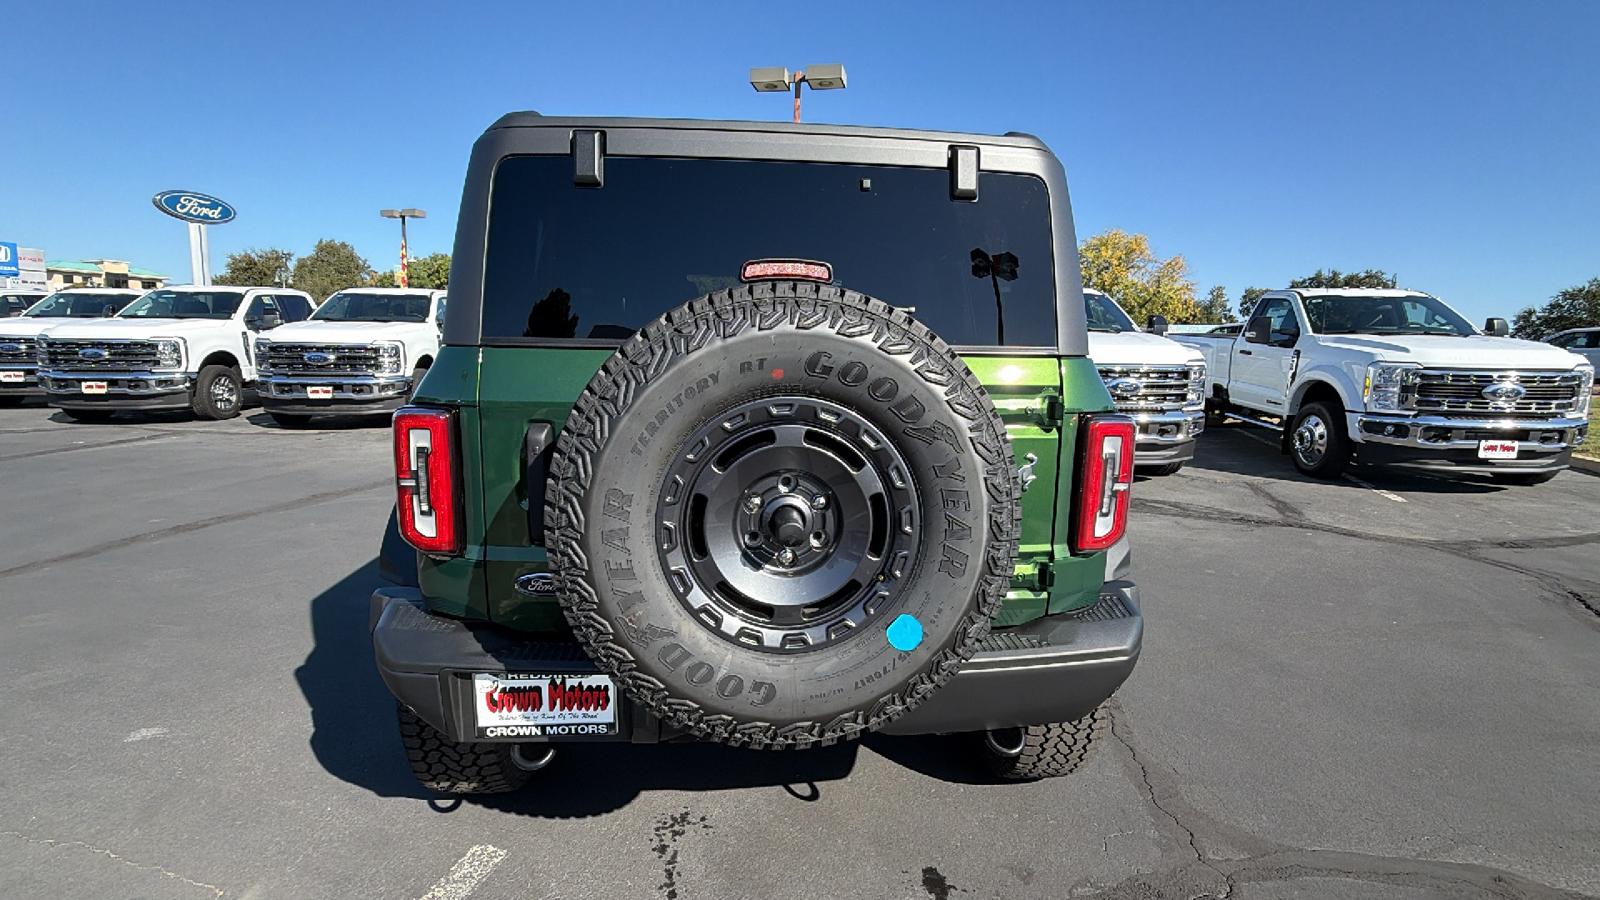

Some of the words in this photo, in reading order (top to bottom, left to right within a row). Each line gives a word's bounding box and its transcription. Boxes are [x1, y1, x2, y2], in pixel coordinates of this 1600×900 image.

[176, 196, 222, 220] Ford
[629, 369, 722, 456] TERRITORY
[739, 357, 768, 376] RT
[485, 684, 543, 714] Crown
[548, 678, 610, 712] Motors
[541, 713, 556, 721] King
[558, 712, 566, 720] Of
[568, 712, 580, 720] The
[486, 726, 542, 737] CROWN
[545, 724, 608, 735] MOTORS
